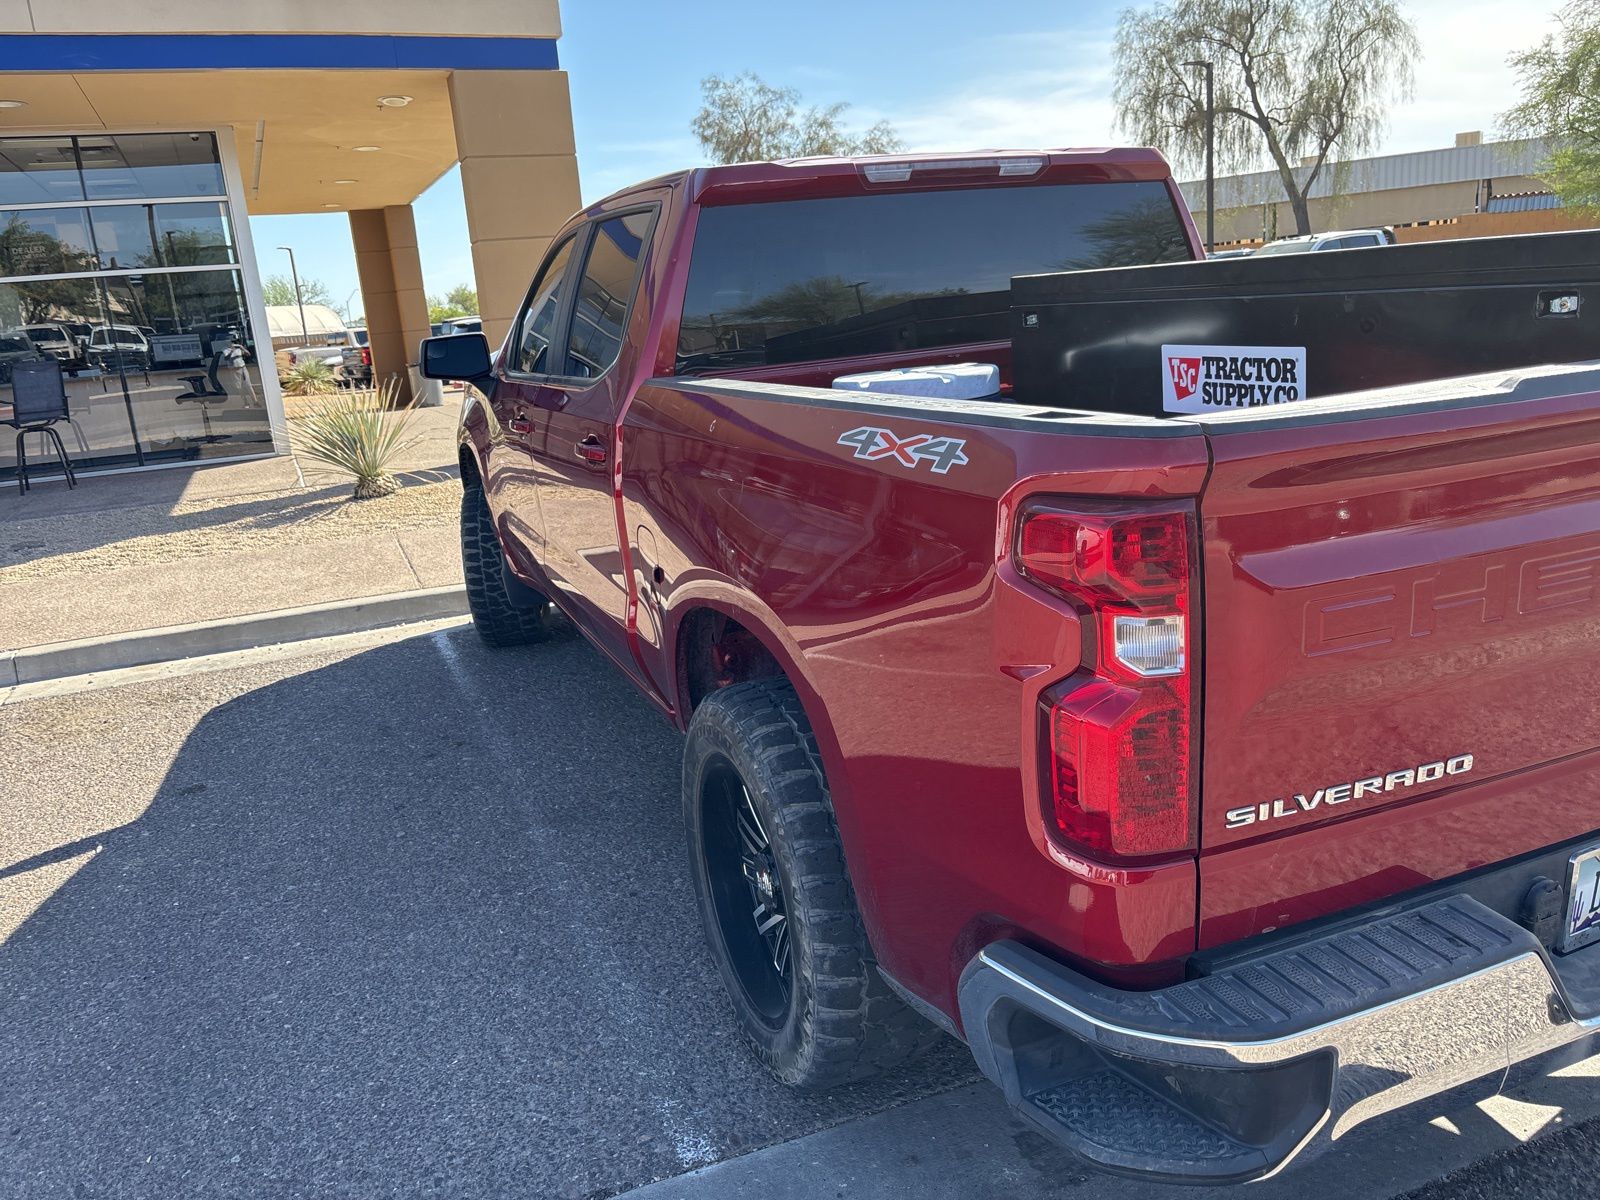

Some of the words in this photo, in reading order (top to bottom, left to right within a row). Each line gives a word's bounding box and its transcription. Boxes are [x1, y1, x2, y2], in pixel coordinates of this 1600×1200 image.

[1171, 359, 1196, 393] TSC
[1202, 356, 1298, 384] TRACTOR
[1202, 382, 1273, 407] SUPPLY
[1225, 753, 1474, 829] SILVERADO
